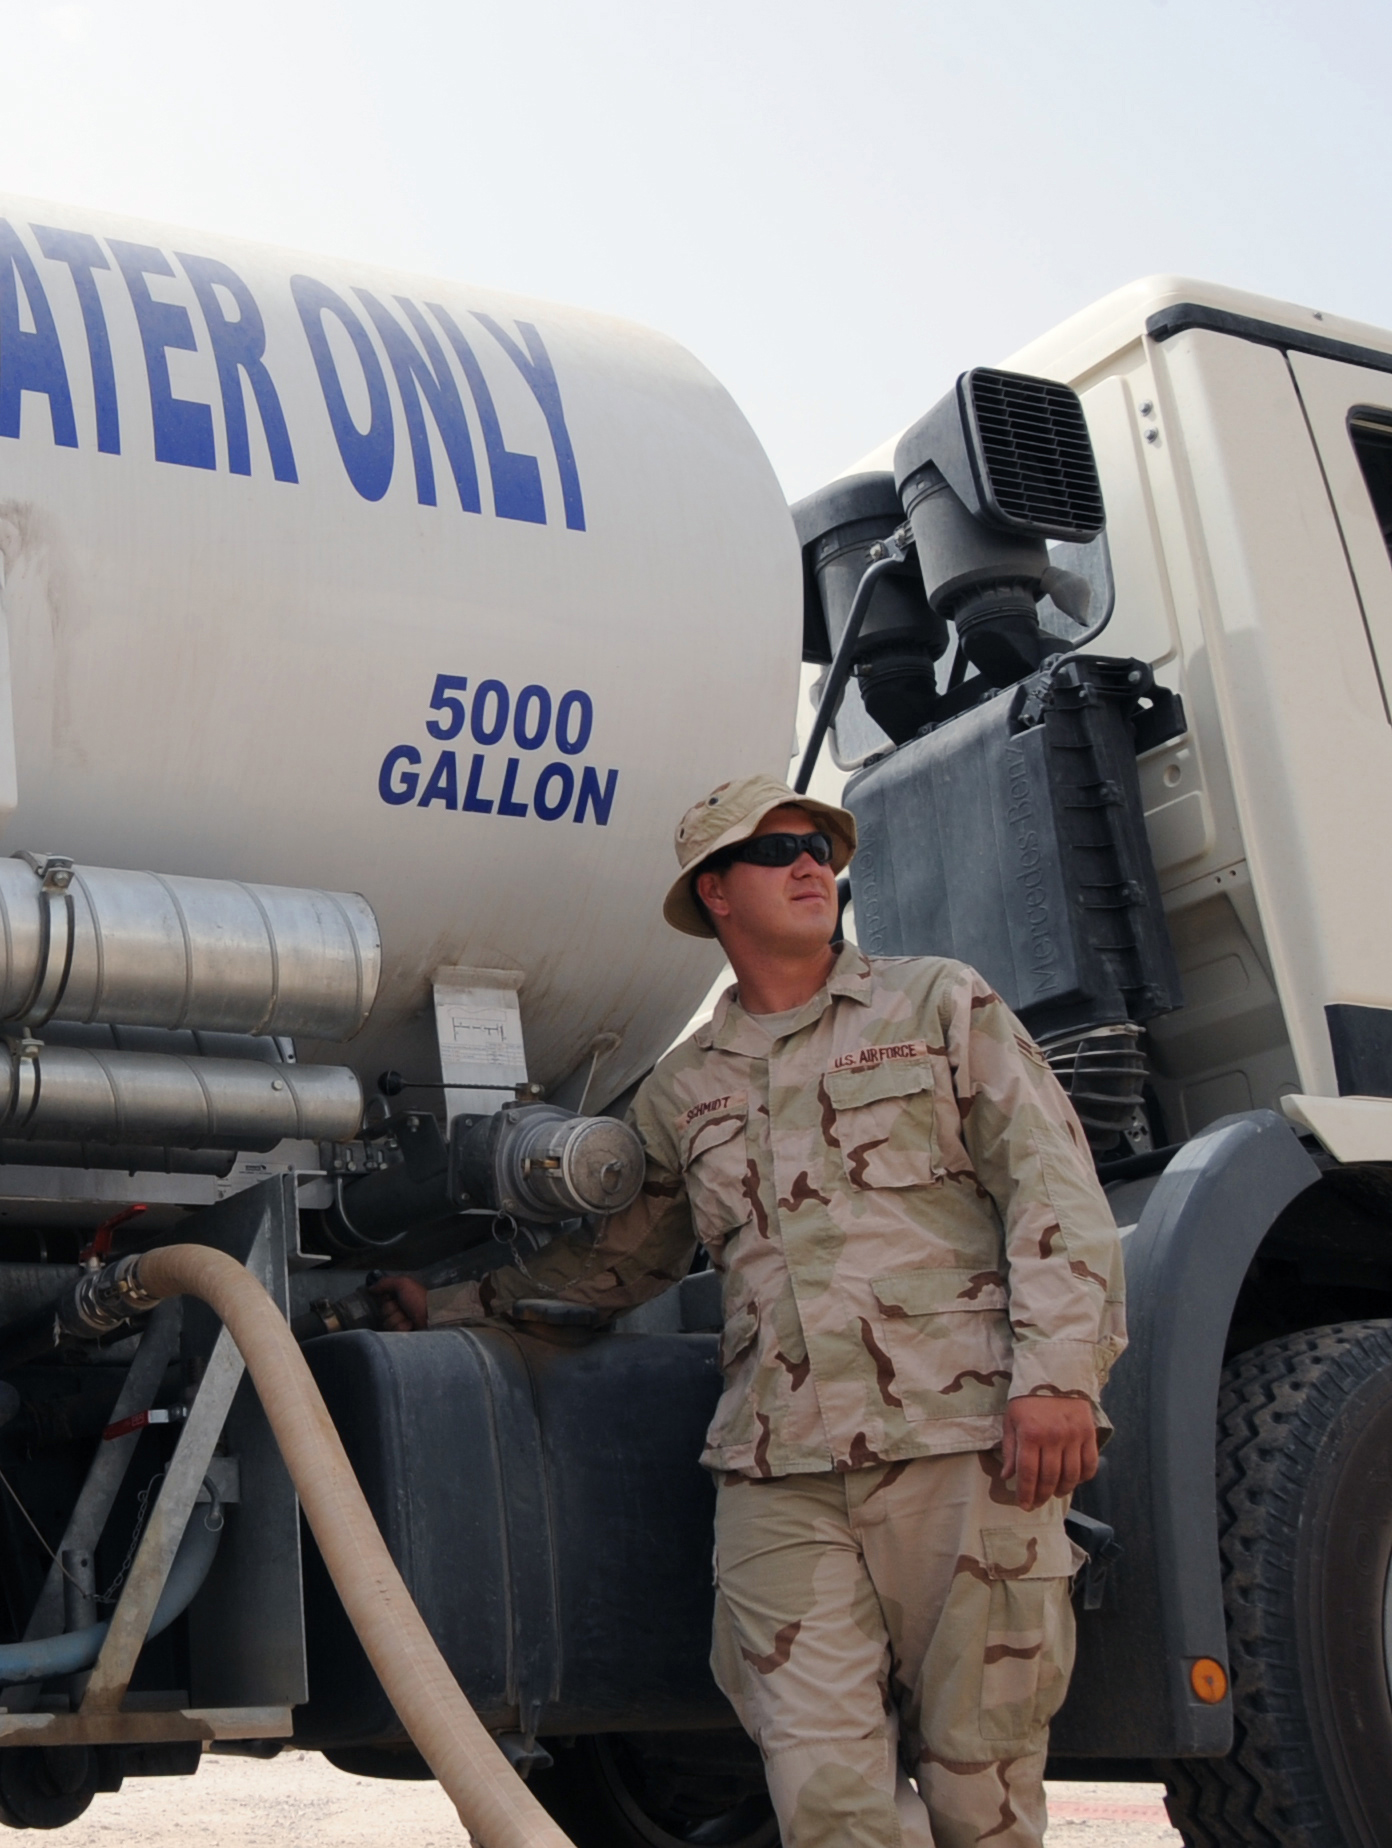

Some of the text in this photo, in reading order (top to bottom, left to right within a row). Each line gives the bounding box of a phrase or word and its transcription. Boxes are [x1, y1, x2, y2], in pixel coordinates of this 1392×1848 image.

[289, 274, 587, 532] ONLY
[425, 673, 593, 755] 5000
[378, 744, 619, 826] GALLON
[855, 821, 888, 956] Mercede
[1007, 738, 1058, 995] Mercedes-Benz
[834, 1044, 917, 1069] U.S. AIR FORCE
[685, 1095, 731, 1124] SCHMIDT
